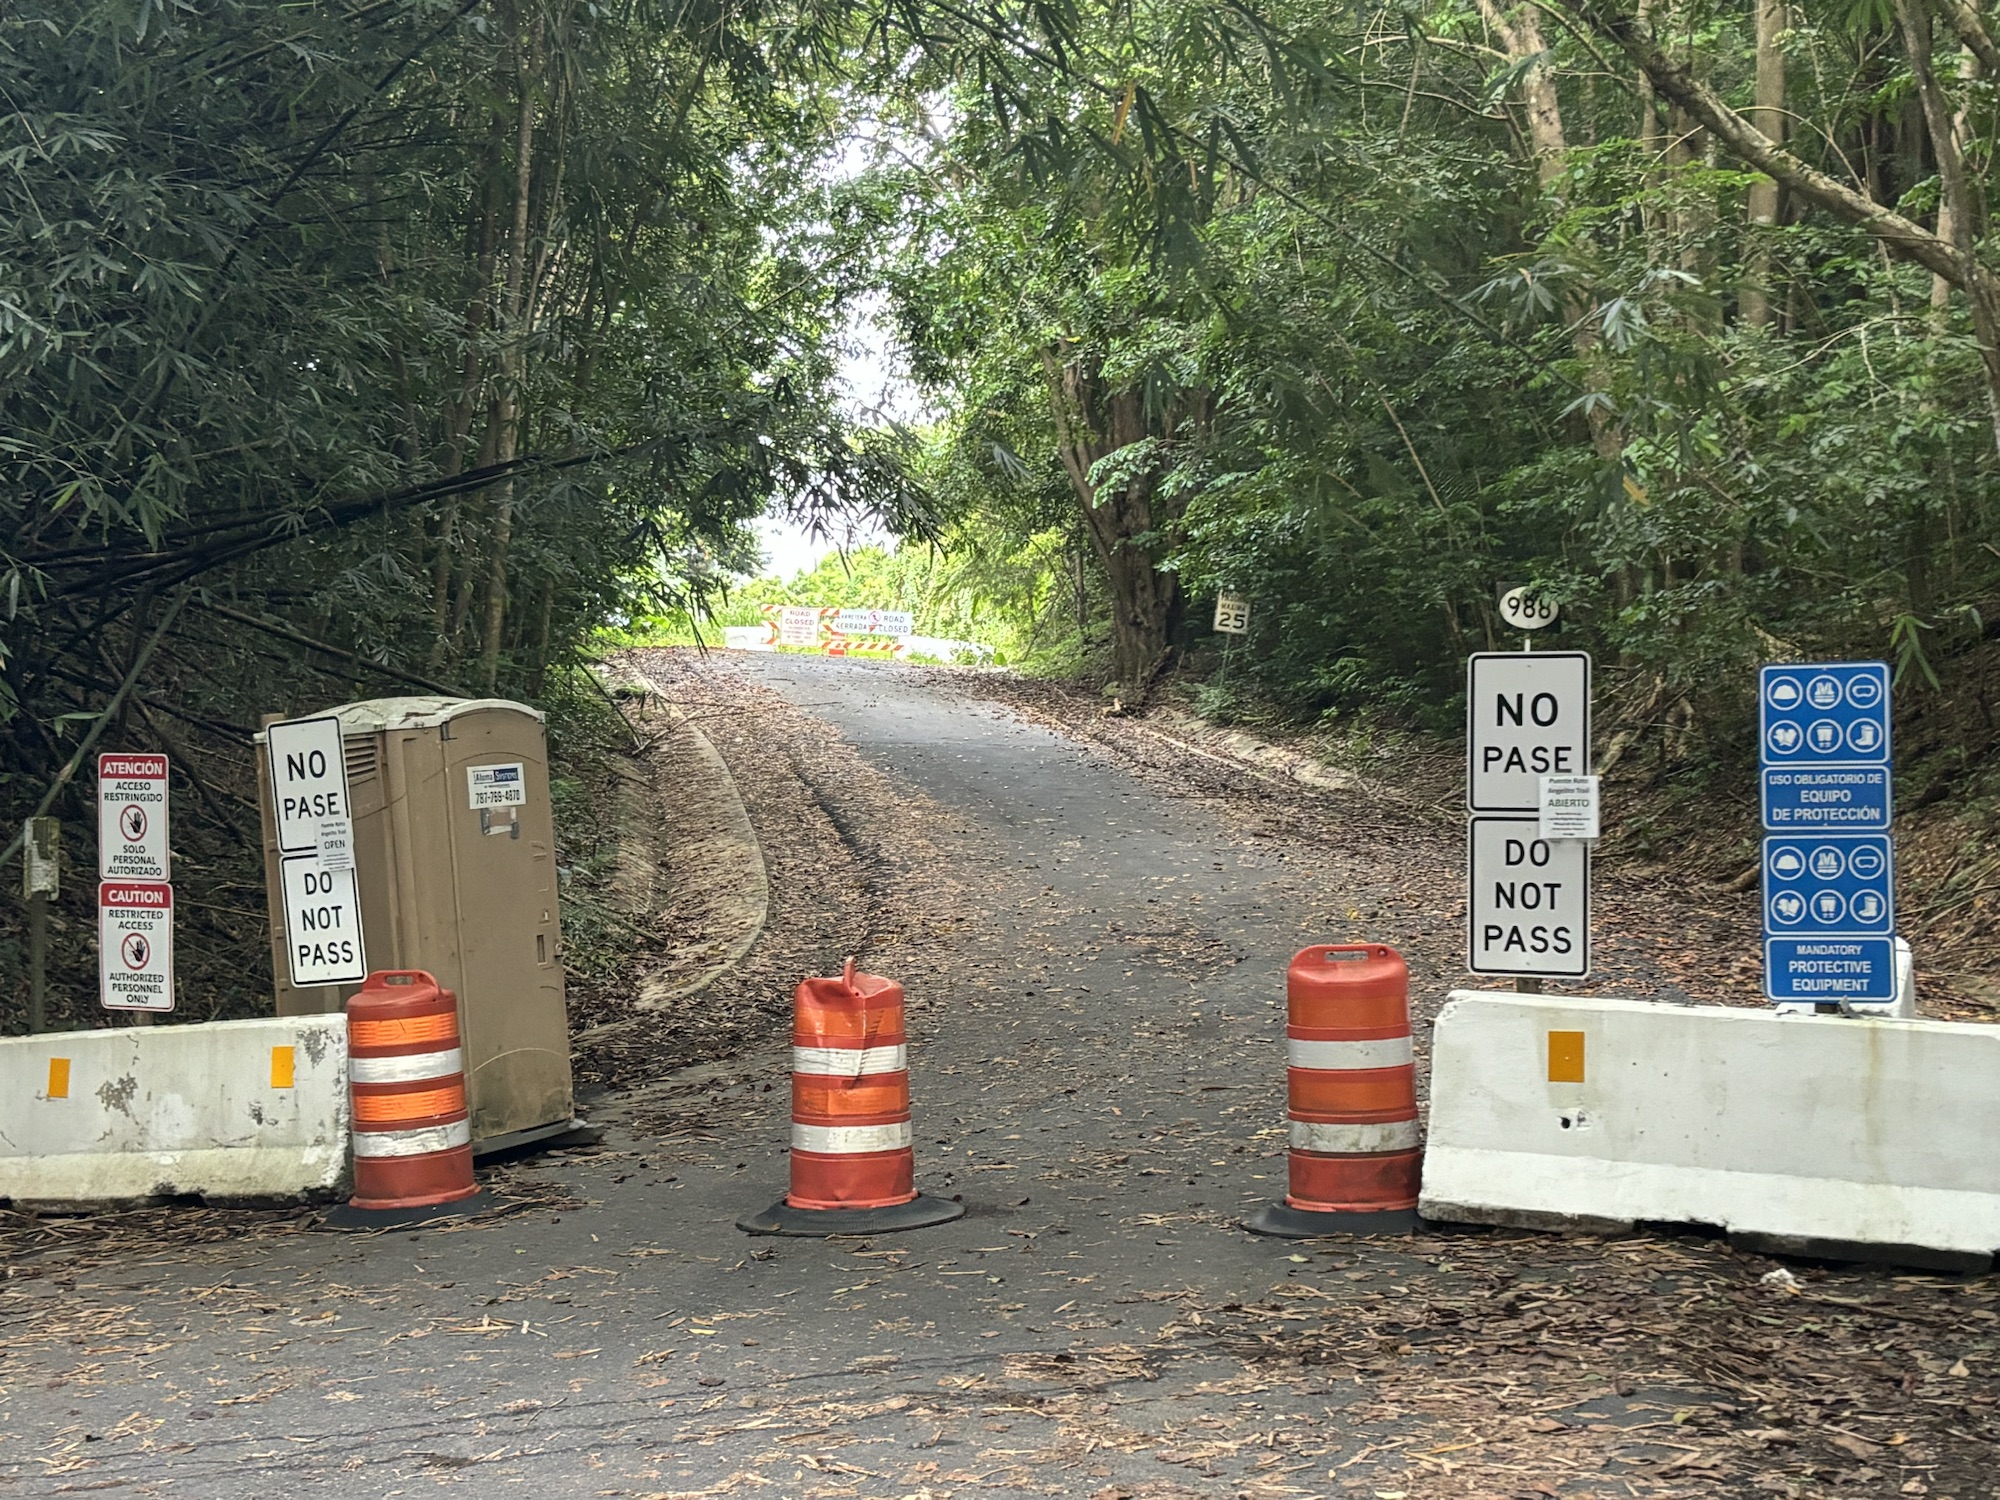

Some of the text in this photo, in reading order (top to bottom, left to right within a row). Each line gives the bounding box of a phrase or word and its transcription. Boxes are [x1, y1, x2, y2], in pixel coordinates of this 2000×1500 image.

[883, 615, 905, 623] ROAD
[1218, 612, 1246, 629] 25
[879, 624, 909, 633] CLOSED
[1496, 692, 1559, 728] NO
[104, 759, 163, 775] ATENCIÓN
[286, 750, 327, 782] NO
[1483, 746, 1573, 774] PASE
[115, 781, 151, 791] ACCESO
[1769, 773, 1883, 786] USO OBLIGATORIO DE
[104, 792, 163, 802] RESTRINGIDO
[1548, 798, 1590, 807] ABIERTO
[1800, 789, 1852, 804] EQUIPO
[284, 792, 341, 820] PASE
[1772, 804, 1880, 822] DE PROTECCIÓN
[123, 845, 146, 854] SOLO
[324, 839, 346, 849] OPEN
[1504, 838, 1550, 867] DO
[113, 855, 156, 865] PERSONAL
[107, 866, 162, 876] AUTORIZADO
[303, 871, 333, 895] DO
[108, 889, 164, 904] CAUTION
[1495, 881, 1562, 911] NOT
[108, 910, 164, 920] RESTRICTED
[301, 905, 343, 931] NOT
[118, 920, 154, 930] ACCESS
[1484, 924, 1573, 954] PASS
[298, 940, 354, 967] PASS
[1796, 944, 1863, 956] MANDATORY
[1788, 960, 1872, 975] PROTECTIVE
[109, 972, 165, 983] AUTHORIZED
[112, 983, 163, 994] PERSONNEL
[1792, 978, 1870, 992] EQUIPMENT
[126, 993, 150, 1004] ONLY
